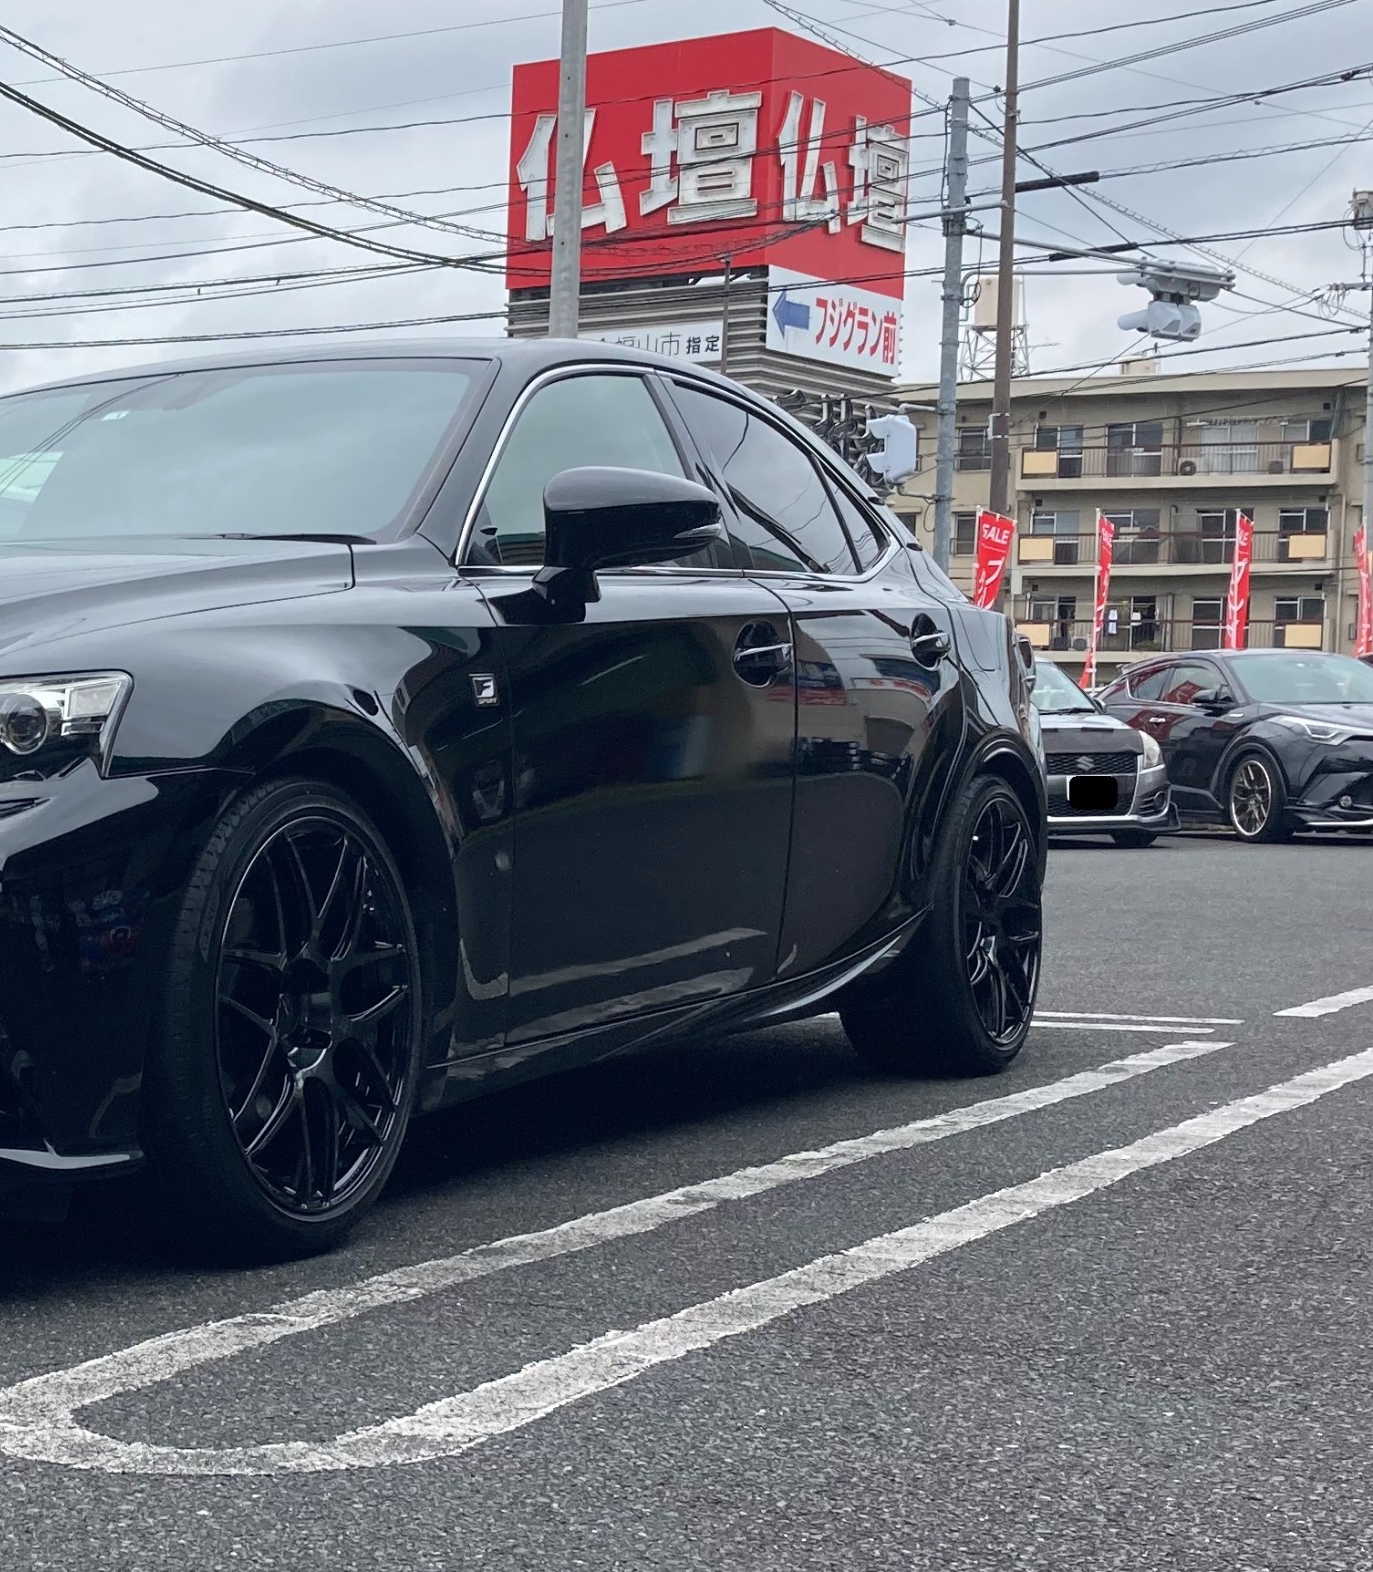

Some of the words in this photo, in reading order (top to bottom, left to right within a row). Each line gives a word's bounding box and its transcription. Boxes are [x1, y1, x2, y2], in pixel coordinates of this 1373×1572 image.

[516, 90, 763, 243] 仏壇
[777, 90, 910, 254] 仏壇
[686, 335, 720, 354] 指定
[815, 297, 898, 365] フジグラン前
[982, 523, 1010, 546] SALE
